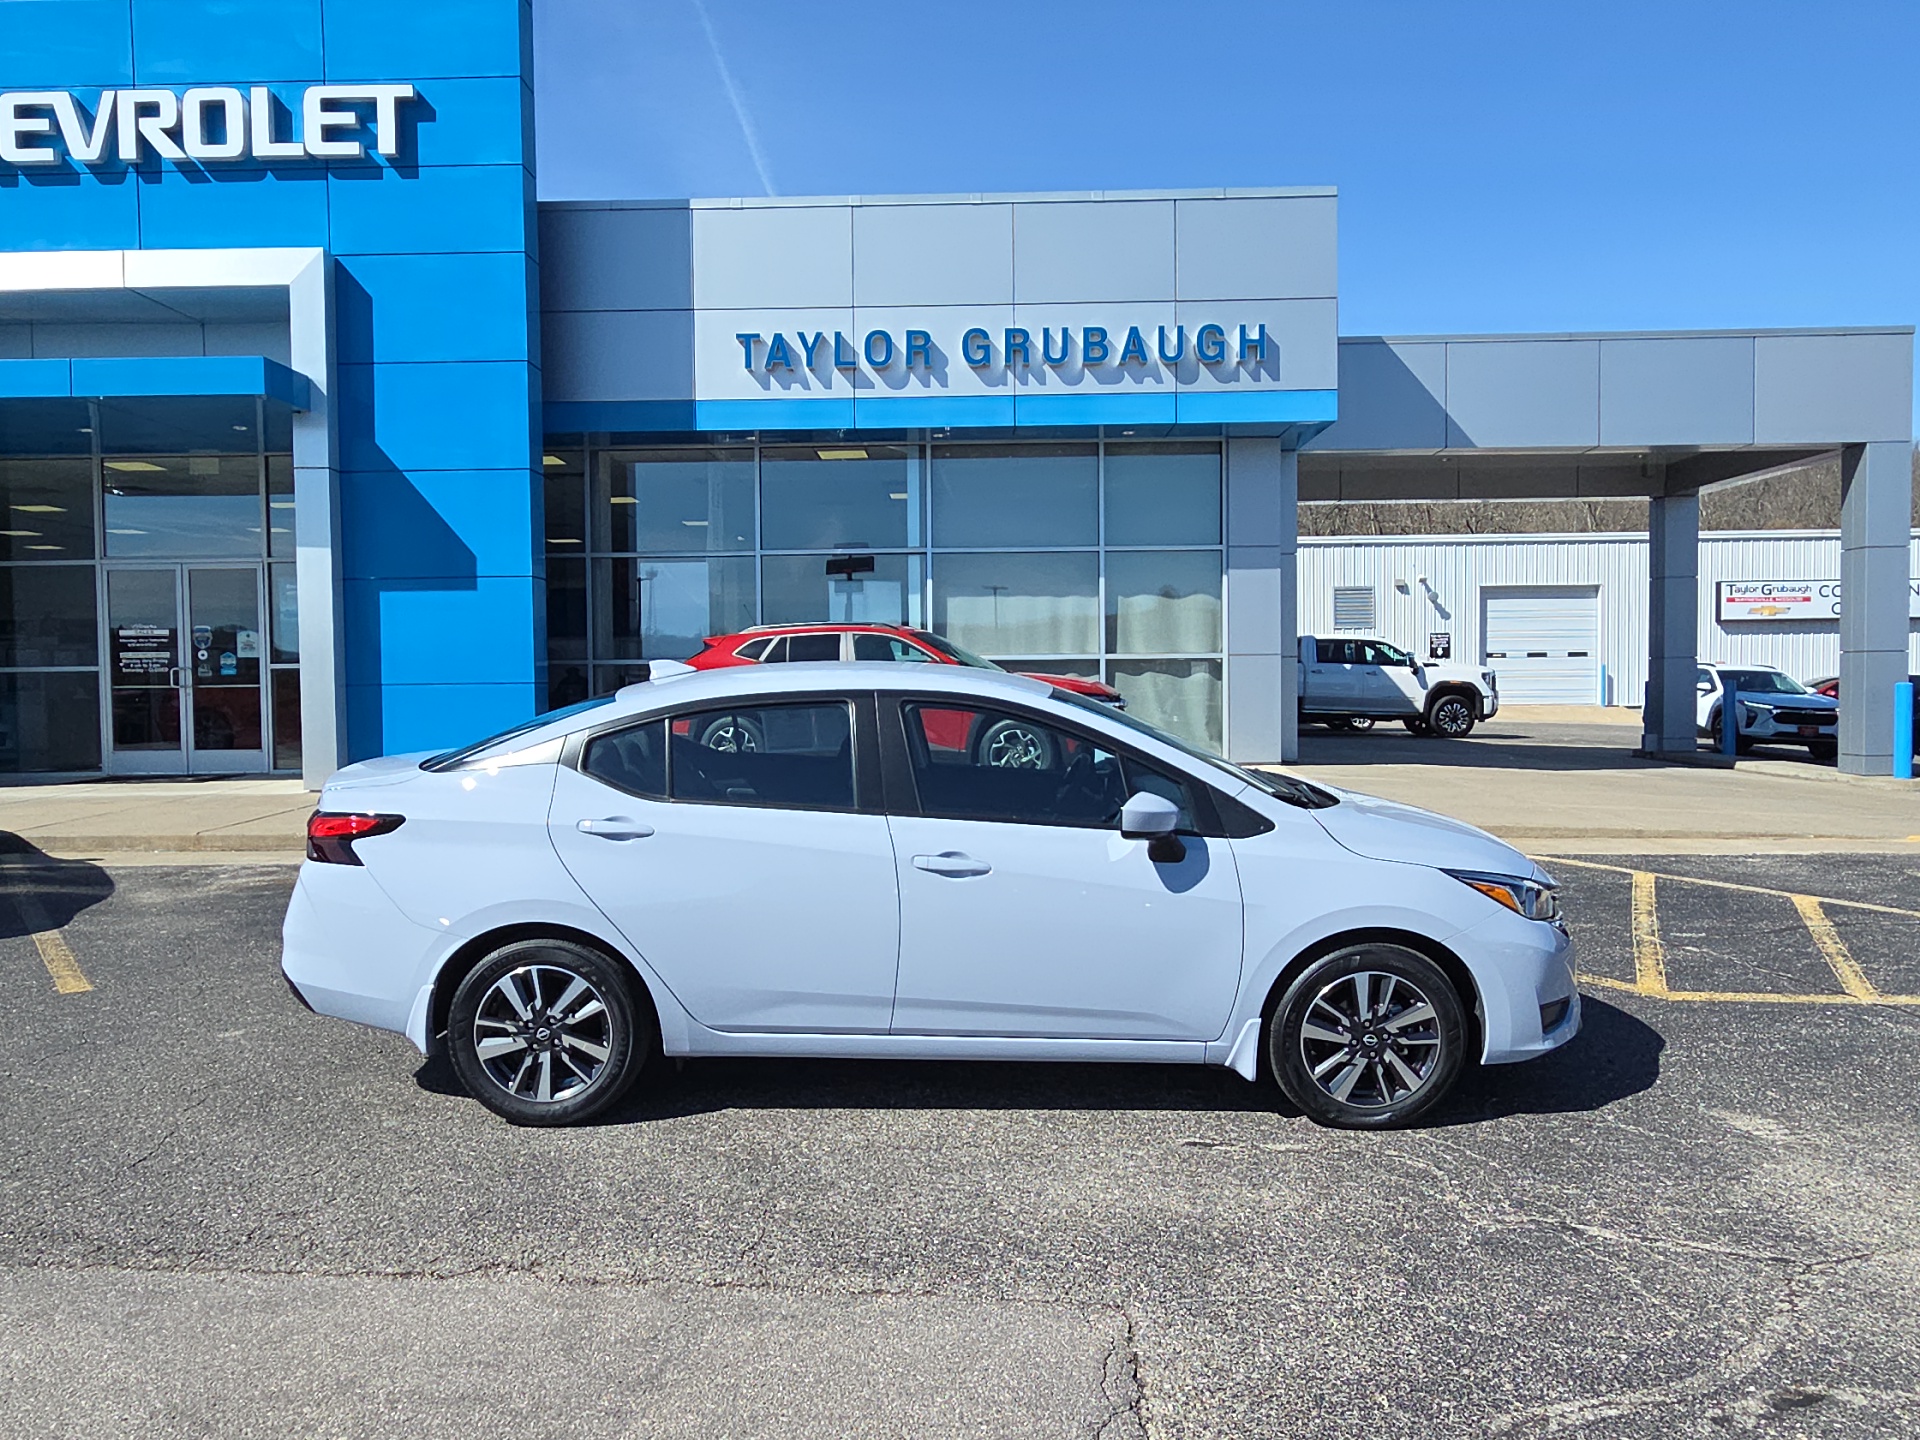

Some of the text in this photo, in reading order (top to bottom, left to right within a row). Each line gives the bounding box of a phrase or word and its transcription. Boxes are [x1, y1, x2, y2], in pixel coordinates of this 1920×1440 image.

[0, 84, 414, 163] EVROLET
[735, 323, 1266, 370] TAYLOR GRUBAUGH
[1726, 584, 1812, 596] Taylor Grubaugh
